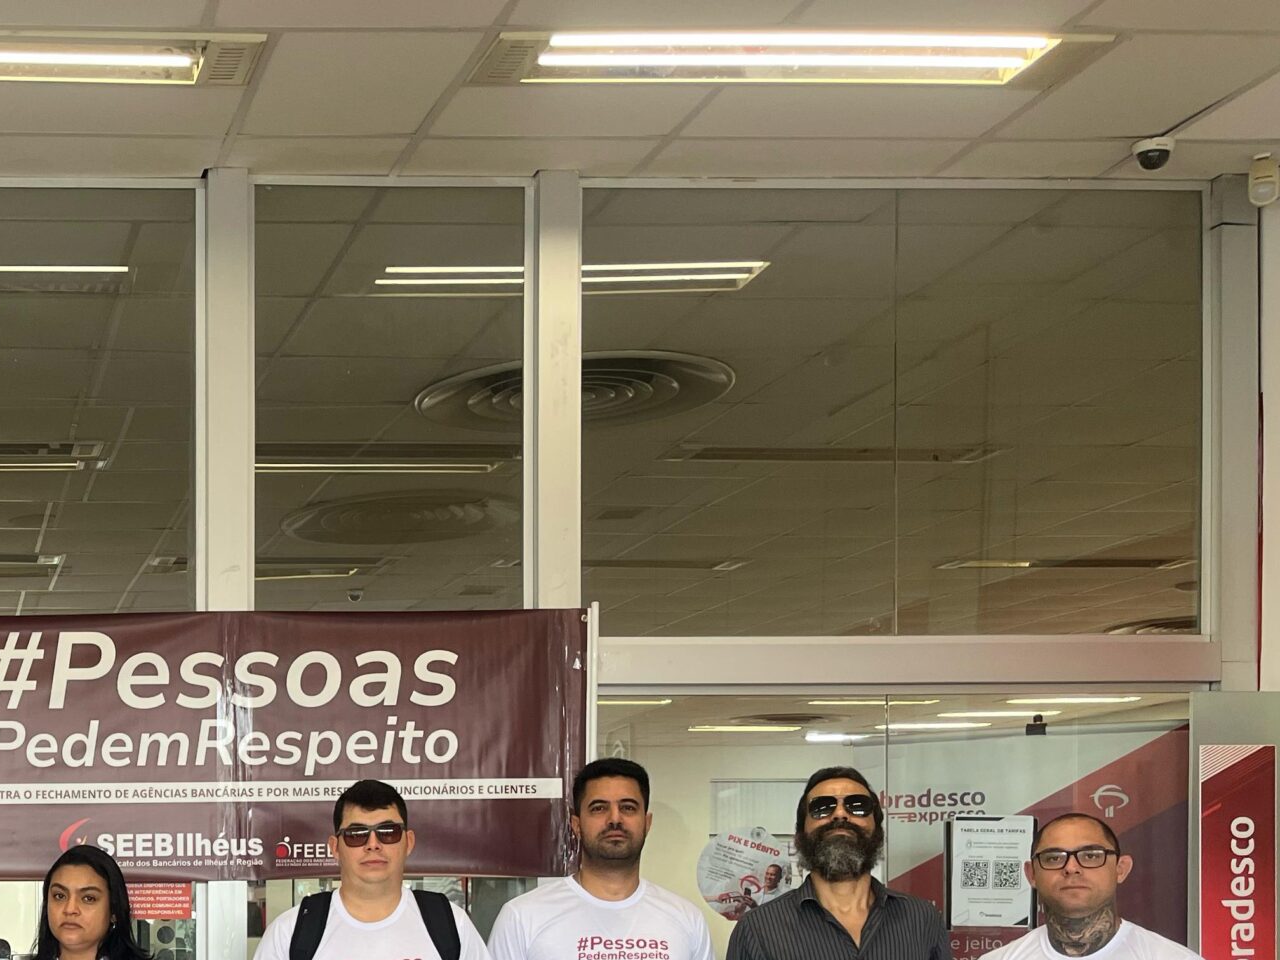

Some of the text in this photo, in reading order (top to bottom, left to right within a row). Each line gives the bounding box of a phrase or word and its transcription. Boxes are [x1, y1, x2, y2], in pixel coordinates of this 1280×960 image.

[23, 790, 32, 800] O
[35, 789, 112, 800] FECHAMENTO
[115, 789, 129, 799] DE
[132, 787, 188, 799] AGÊNCIAS
[191, 786, 254, 798] BANCÁRIAS
[257, 788, 263, 797] E
[266, 787, 289, 797] POR
[292, 787, 320, 797] MAIS
[395, 783, 474, 796] UNCIONÁRIOS
[478, 785, 484, 795] E
[487, 784, 537, 795] CLIENTES
[880, 788, 986, 809] bradesco
[728, 834, 780, 856] PIX E DÉBITO
[136, 859, 151, 867] dos
[153, 859, 191, 867] Bancários
[236, 858, 264, 868] Região
[577, 936, 669, 951] #Pessoas
[965, 936, 1003, 953] jeito
[578, 951, 670, 960] PedemRespeito
